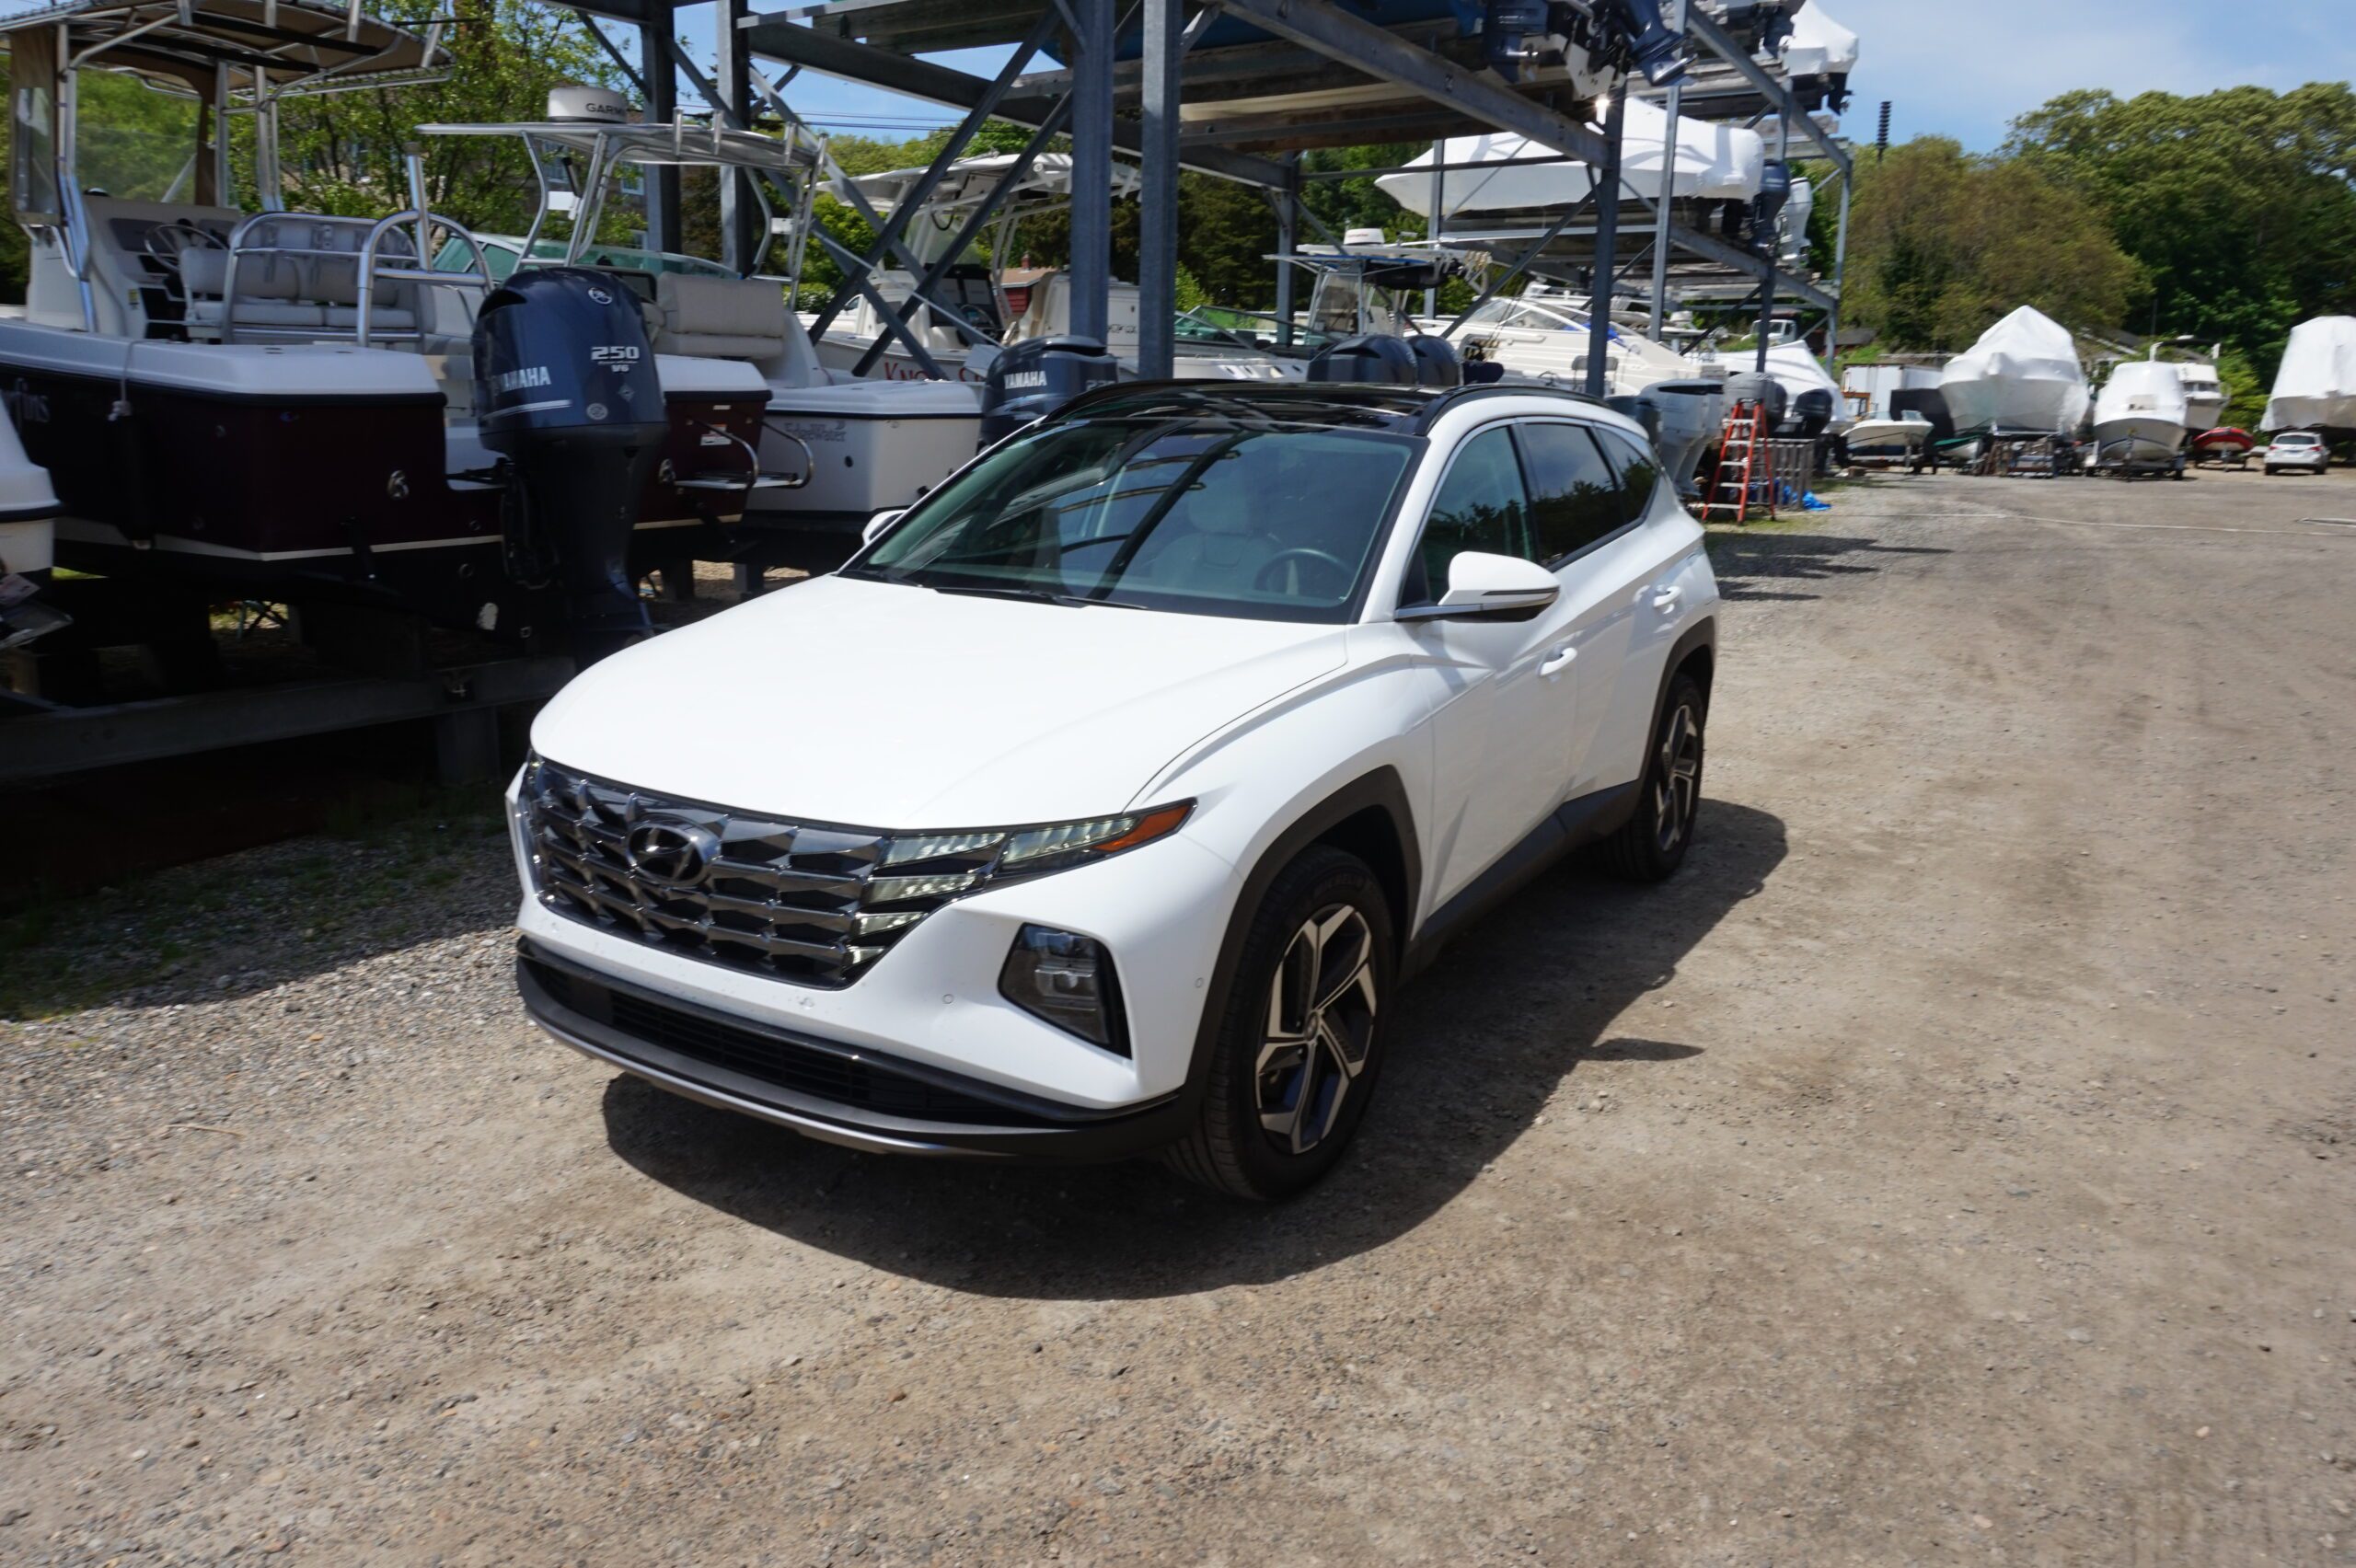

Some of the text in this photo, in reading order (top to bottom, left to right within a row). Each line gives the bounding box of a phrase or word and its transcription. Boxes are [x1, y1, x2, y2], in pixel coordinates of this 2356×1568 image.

[585, 102, 626, 117] GARM
[591, 346, 640, 360] 250
[1004, 371, 1047, 390] YAMAHA
